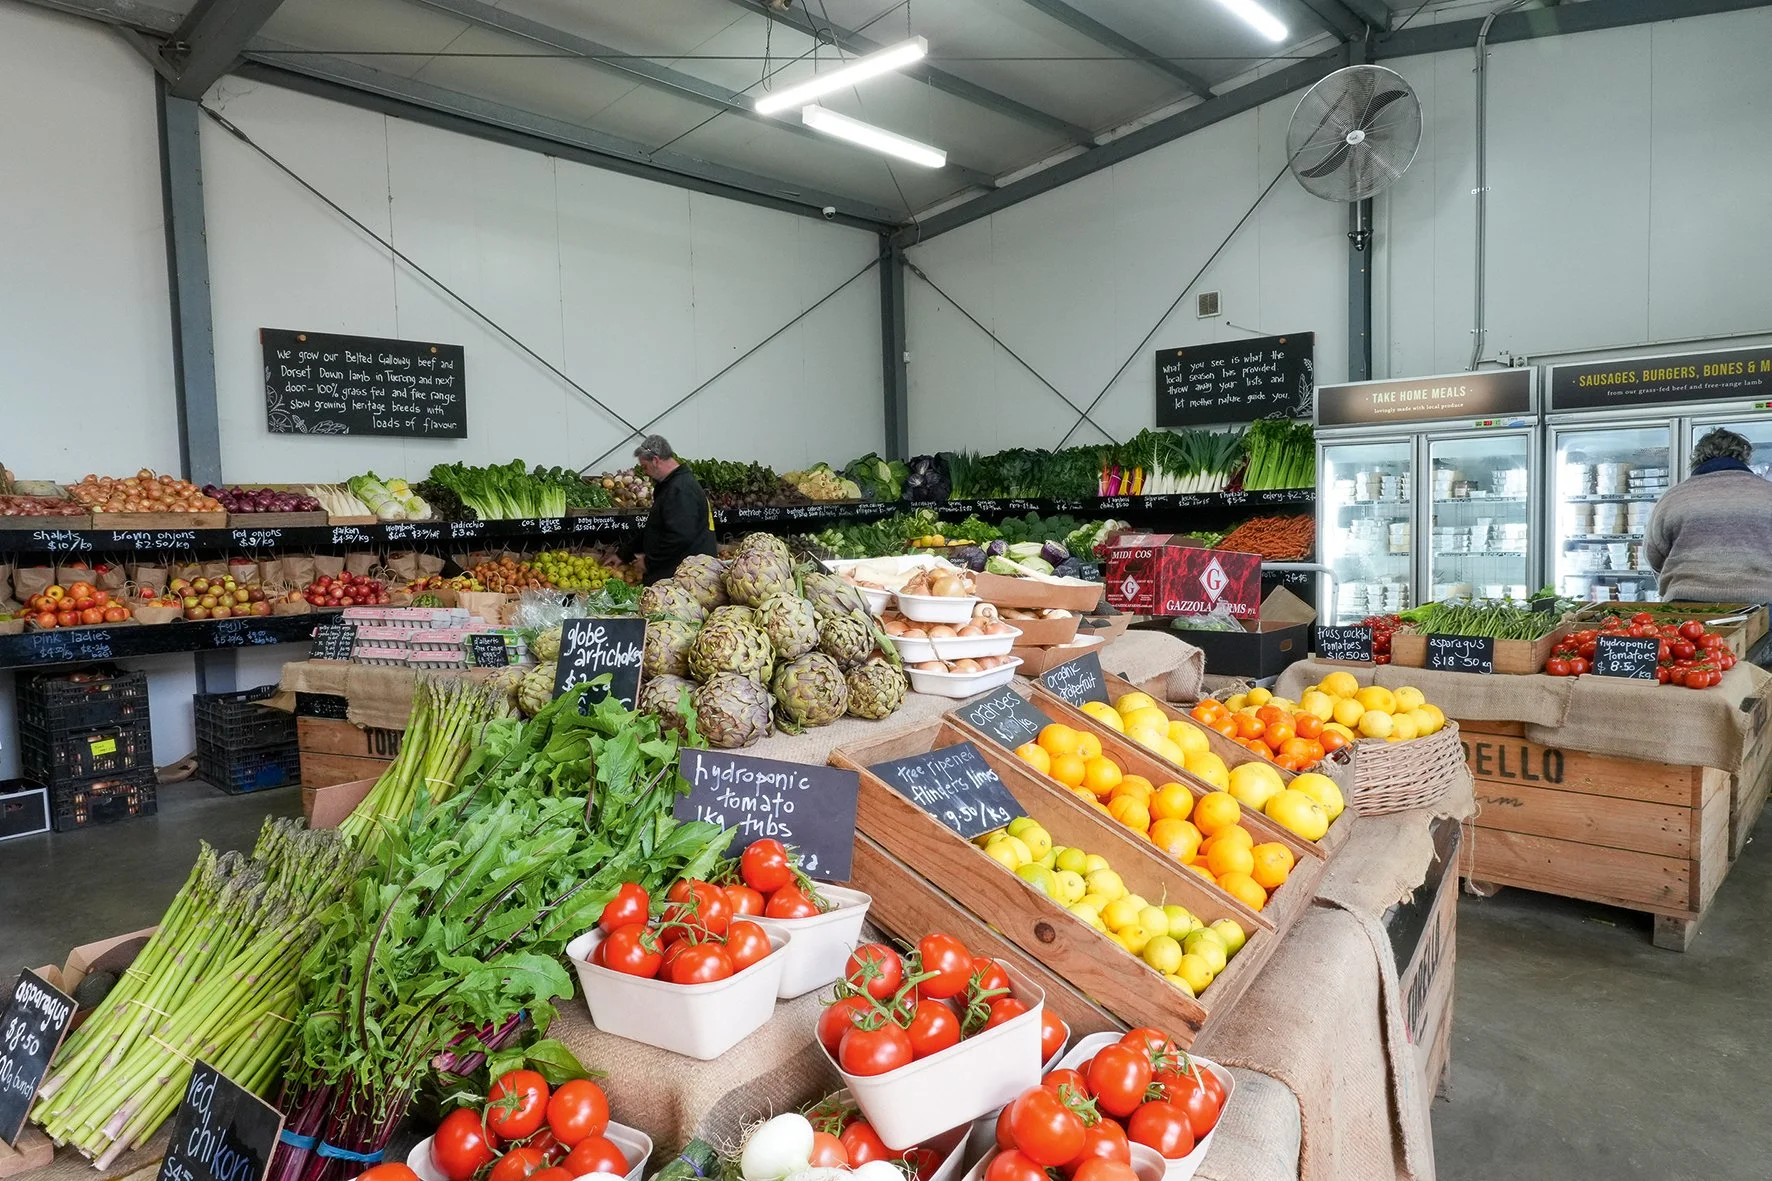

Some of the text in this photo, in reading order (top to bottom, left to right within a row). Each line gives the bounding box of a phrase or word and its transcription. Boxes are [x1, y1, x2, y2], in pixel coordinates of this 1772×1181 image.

[277, 351, 454, 370] We grow our Belted Galloway beef and
[1190, 362, 1204, 372] you
[1211, 359, 1225, 367] see
[1232, 356, 1240, 364] is
[1244, 352, 1262, 363] what
[1270, 351, 1285, 360] the
[281, 365, 311, 379] Dorset
[320, 368, 343, 380] Down
[349, 370, 370, 381] lamb
[376, 372, 383, 381] in
[419, 374, 432, 384] and
[435, 376, 455, 386] next
[1166, 374, 1182, 384] local
[1189, 372, 1215, 382] season
[1223, 369, 1236, 378] has
[1168, 373, 1285, 395] throw away your lists and
[1579, 370, 1640, 387] SAUSAGES,
[1642, 366, 1700, 382] BURGERS,
[1703, 361, 1743, 377] BONES
[1748, 360, 1756, 373] &
[317, 383, 339, 398] 100%
[342, 388, 367, 400] grass
[370, 386, 385, 397] fed
[392, 388, 407, 398] and
[410, 388, 426, 400] free
[431, 392, 456, 405] range
[1372, 386, 1466, 404] TAKE HOME MEALS
[1638, 386, 1670, 395] grass-fed
[1704, 380, 1742, 389] free-range
[315, 401, 346, 416] growing
[352, 402, 386, 416] heritage
[392, 401, 420, 413] breeds
[427, 404, 444, 416] with
[1175, 399, 1184, 409] let
[1190, 398, 1213, 408] mother
[1218, 394, 1241, 405] nature
[1247, 392, 1266, 403] guide
[373, 416, 400, 429] loads
[405, 419, 415, 430] of
[113, 530, 195, 541] brown onions
[232, 528, 282, 539] red onions
[1111, 550, 1152, 559] MIDI COS
[1206, 568, 1221, 591] G
[1166, 600, 1212, 612] GAZZOLA
[32, 630, 111, 648] pink ladies
[563, 622, 608, 656] globe
[1318, 627, 1340, 640] truss
[1600, 637, 1655, 651] hydroponic
[1321, 639, 1361, 651] tomatoes
[1430, 638, 1485, 658] asparagus
[574, 642, 643, 672] artichokes
[1604, 649, 1656, 663] tomatoes
[363, 726, 405, 756] TOR
[927, 745, 975, 780] ripened
[694, 754, 811, 796] hydroponic
[911, 768, 999, 806] flinders limes
[716, 787, 795, 818] tomato
[740, 814, 793, 837] tubs
[15, 980, 69, 1031] asparagus
[5, 1017, 39, 1056] $8.50
[12, 1065, 36, 1101] bunch
[187, 1073, 219, 1124] red
